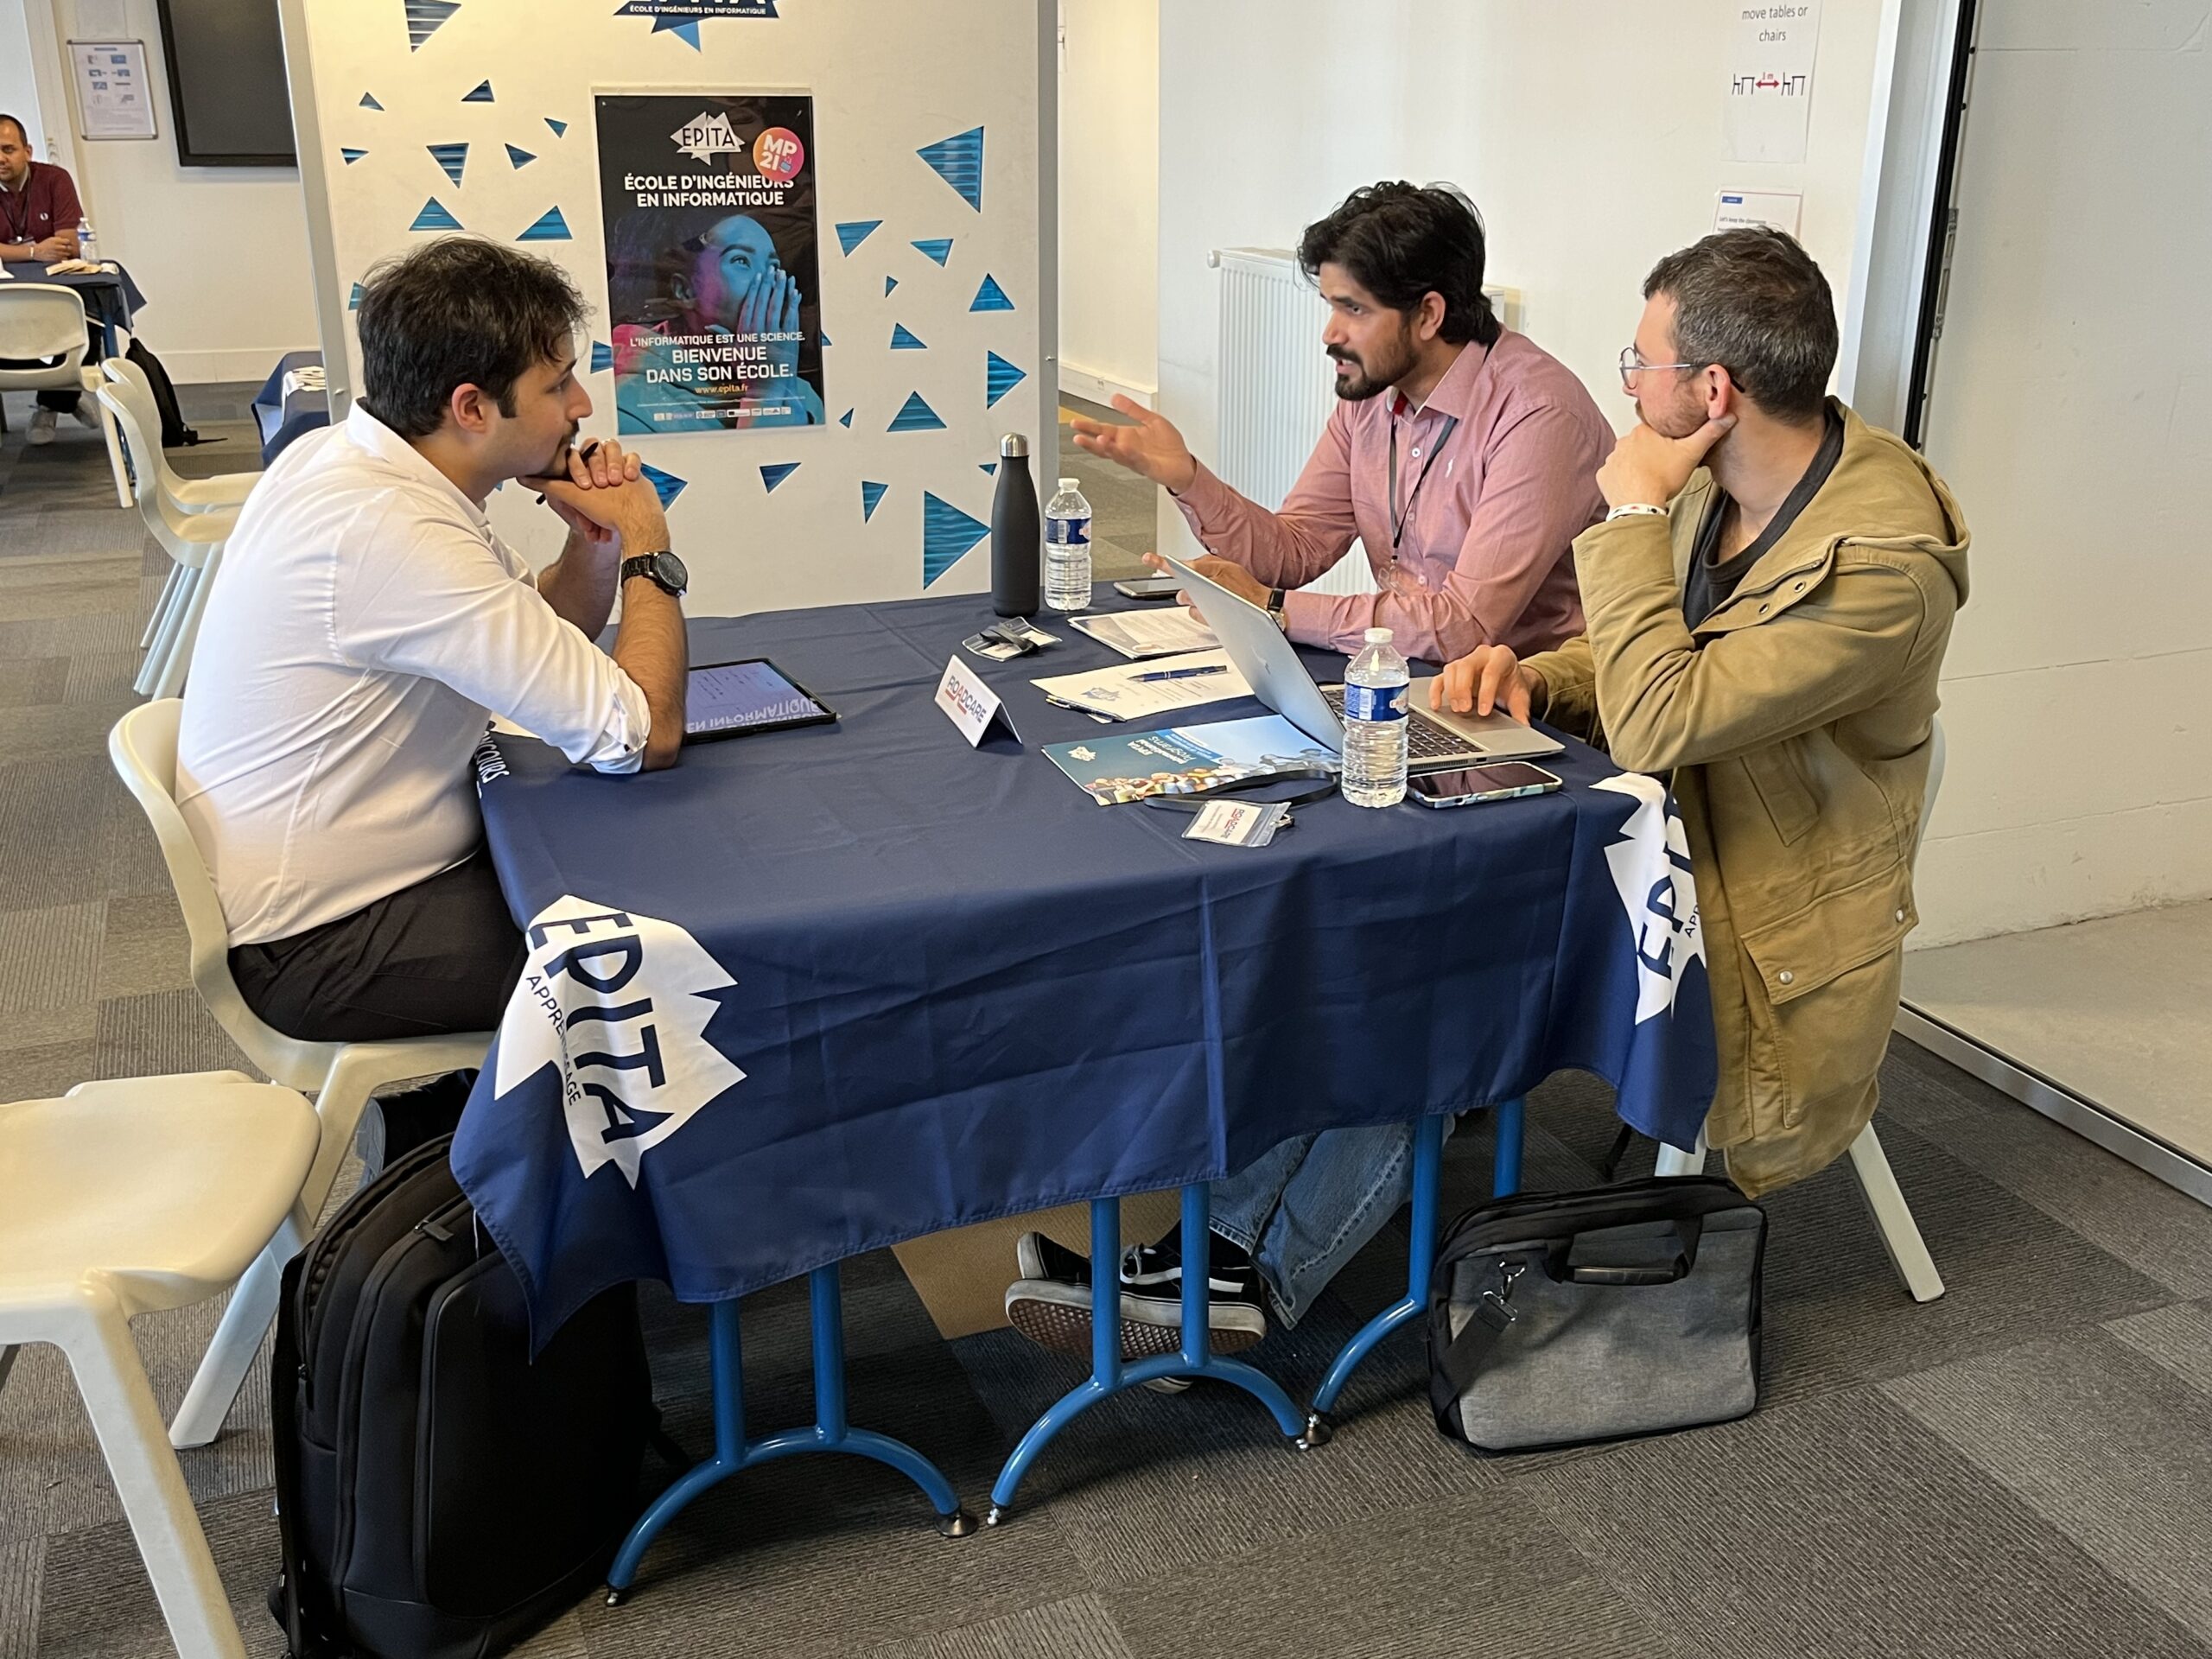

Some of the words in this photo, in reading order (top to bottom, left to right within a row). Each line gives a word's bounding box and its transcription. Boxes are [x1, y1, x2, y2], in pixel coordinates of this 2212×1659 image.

[1742, 9, 1767, 20] move
[1769, 4, 1796, 18] tables
[1797, 5, 1808, 16] or
[1759, 29, 1787, 41] chairs
[682, 127, 736, 147] EPITA
[763, 134, 798, 157] MP
[624, 173, 677, 190] ÉCOLE
[637, 192, 659, 207] EN
[663, 191, 785, 207] INFORMATIQUE
[630, 334, 714, 347] L'INFORMATIQUE
[715, 334, 734, 344] EST
[737, 333, 758, 343] UNE
[760, 331, 805, 342] SCIENCE.
[672, 346, 767, 365] BIENVENUE
[646, 368, 693, 384] DANS
[697, 365, 732, 381] SON
[737, 362, 794, 380] ÉCOLE.
[695, 384, 749, 395] www.epita.fr
[947, 675, 987, 723] ROADCARE
[526, 912, 675, 1145] EPITA
